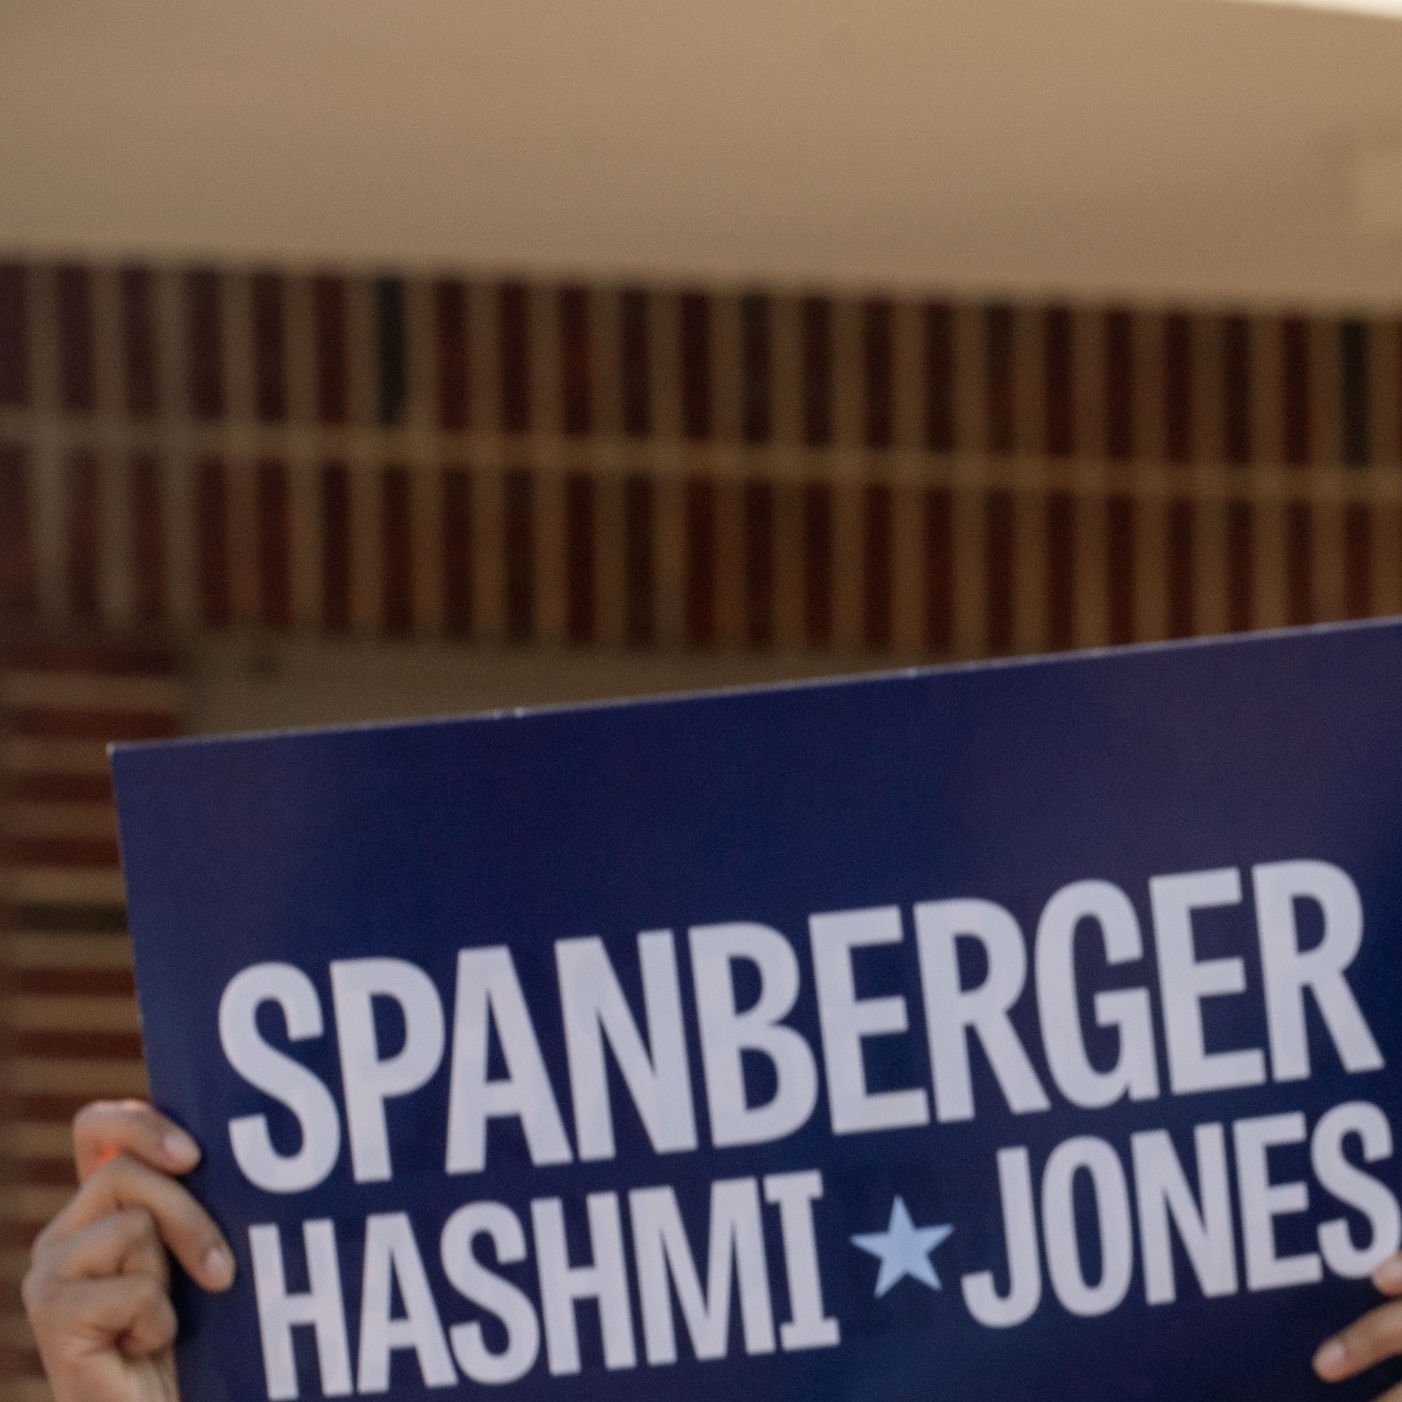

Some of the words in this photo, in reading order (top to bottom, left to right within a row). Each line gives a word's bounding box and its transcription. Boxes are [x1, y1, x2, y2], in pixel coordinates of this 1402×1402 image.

[218, 859, 1384, 1193] SPANBERGER
[248, 1171, 841, 1401] HASHMI
[961, 1102, 1402, 1328] JONES
